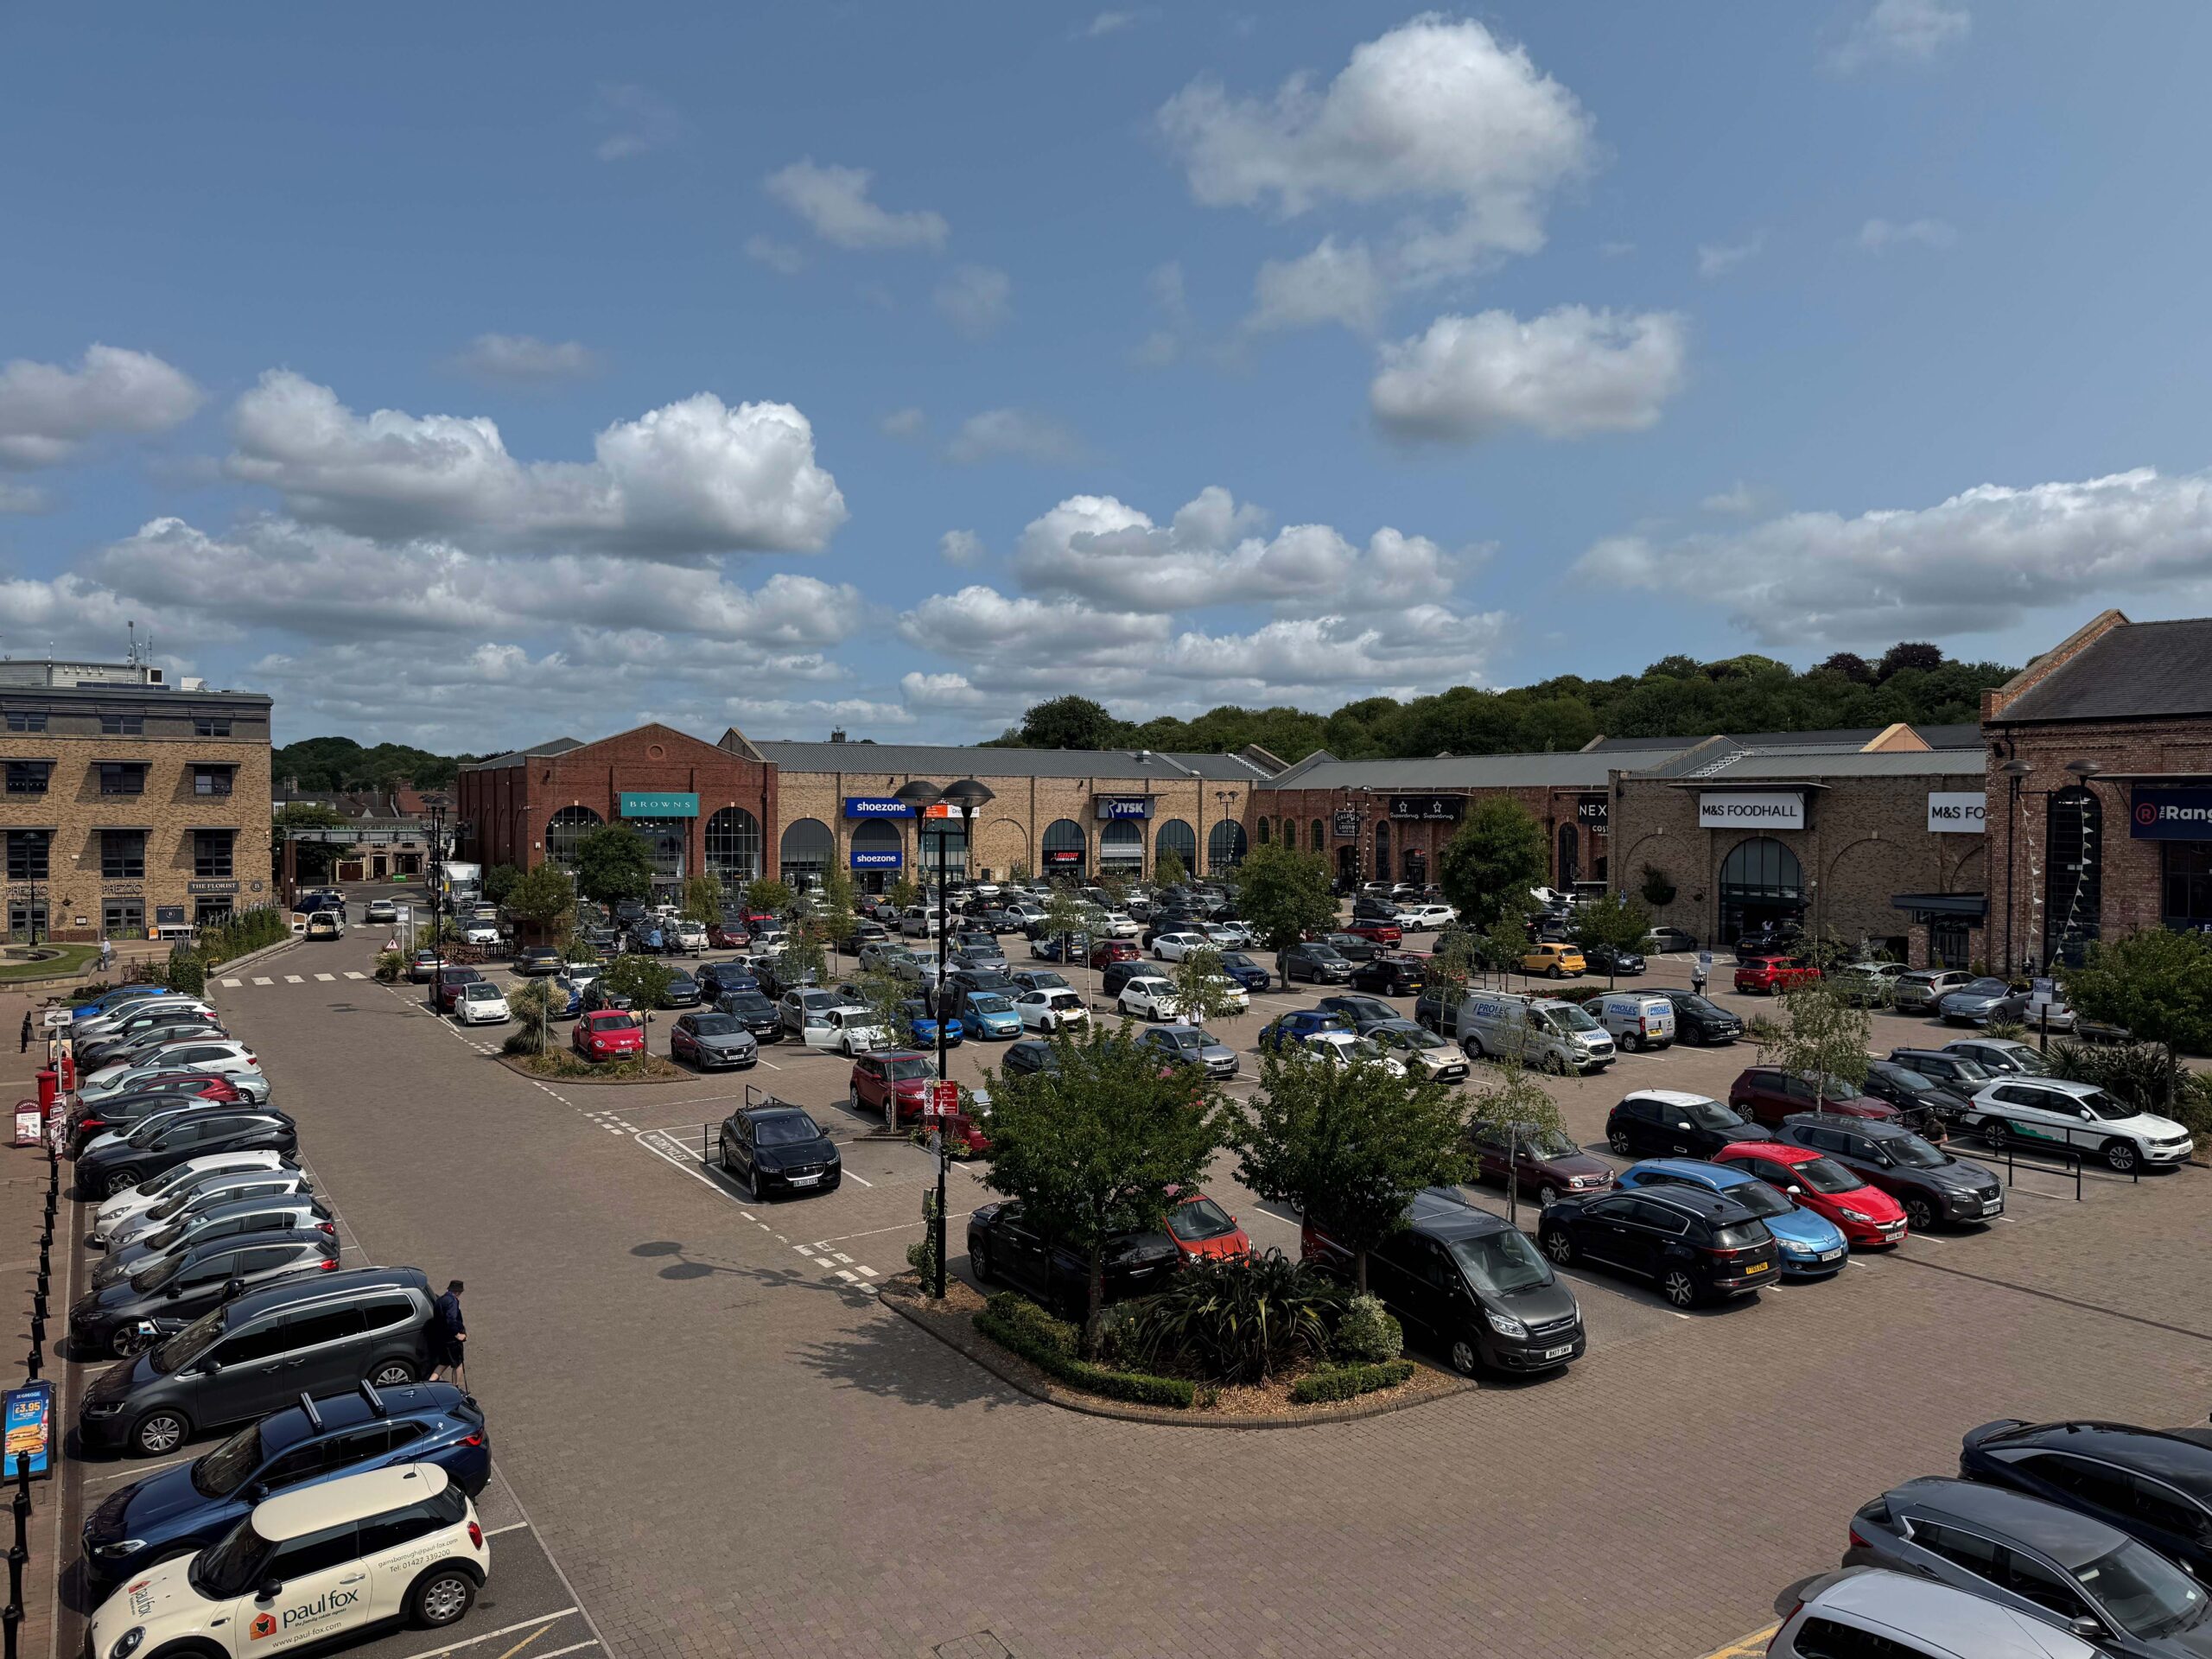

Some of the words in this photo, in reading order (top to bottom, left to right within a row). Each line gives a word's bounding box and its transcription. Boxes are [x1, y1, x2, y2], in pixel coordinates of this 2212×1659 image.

[856, 802, 906, 812] shoezone
[1116, 803, 1144, 813] JYSK
[1702, 805, 1725, 816] M&S
[1727, 805, 1797, 817] FOODHALL
[1932, 806, 1961, 818] M&S
[1389, 811, 1419, 820] Superdrug
[1423, 812, 1454, 821] Superdrug
[856, 854, 897, 863] shoezone
[6, 885, 49, 895] PREZZO
[103, 884, 143, 894] PREZZO
[1478, 1002, 1511, 1015] PROLEC
[1611, 1003, 1639, 1014] PROLEC
[1649, 1004, 1670, 1014] PROLEC
[16, 1402, 41, 1414] £3.95
[403, 1557, 423, 1569] 01427
[426, 1548, 451, 1562] 339200
[283, 1593, 326, 1629] paul
[328, 1589, 359, 1610] fox
[271, 1621, 342, 1648] www.paul-fox.com
